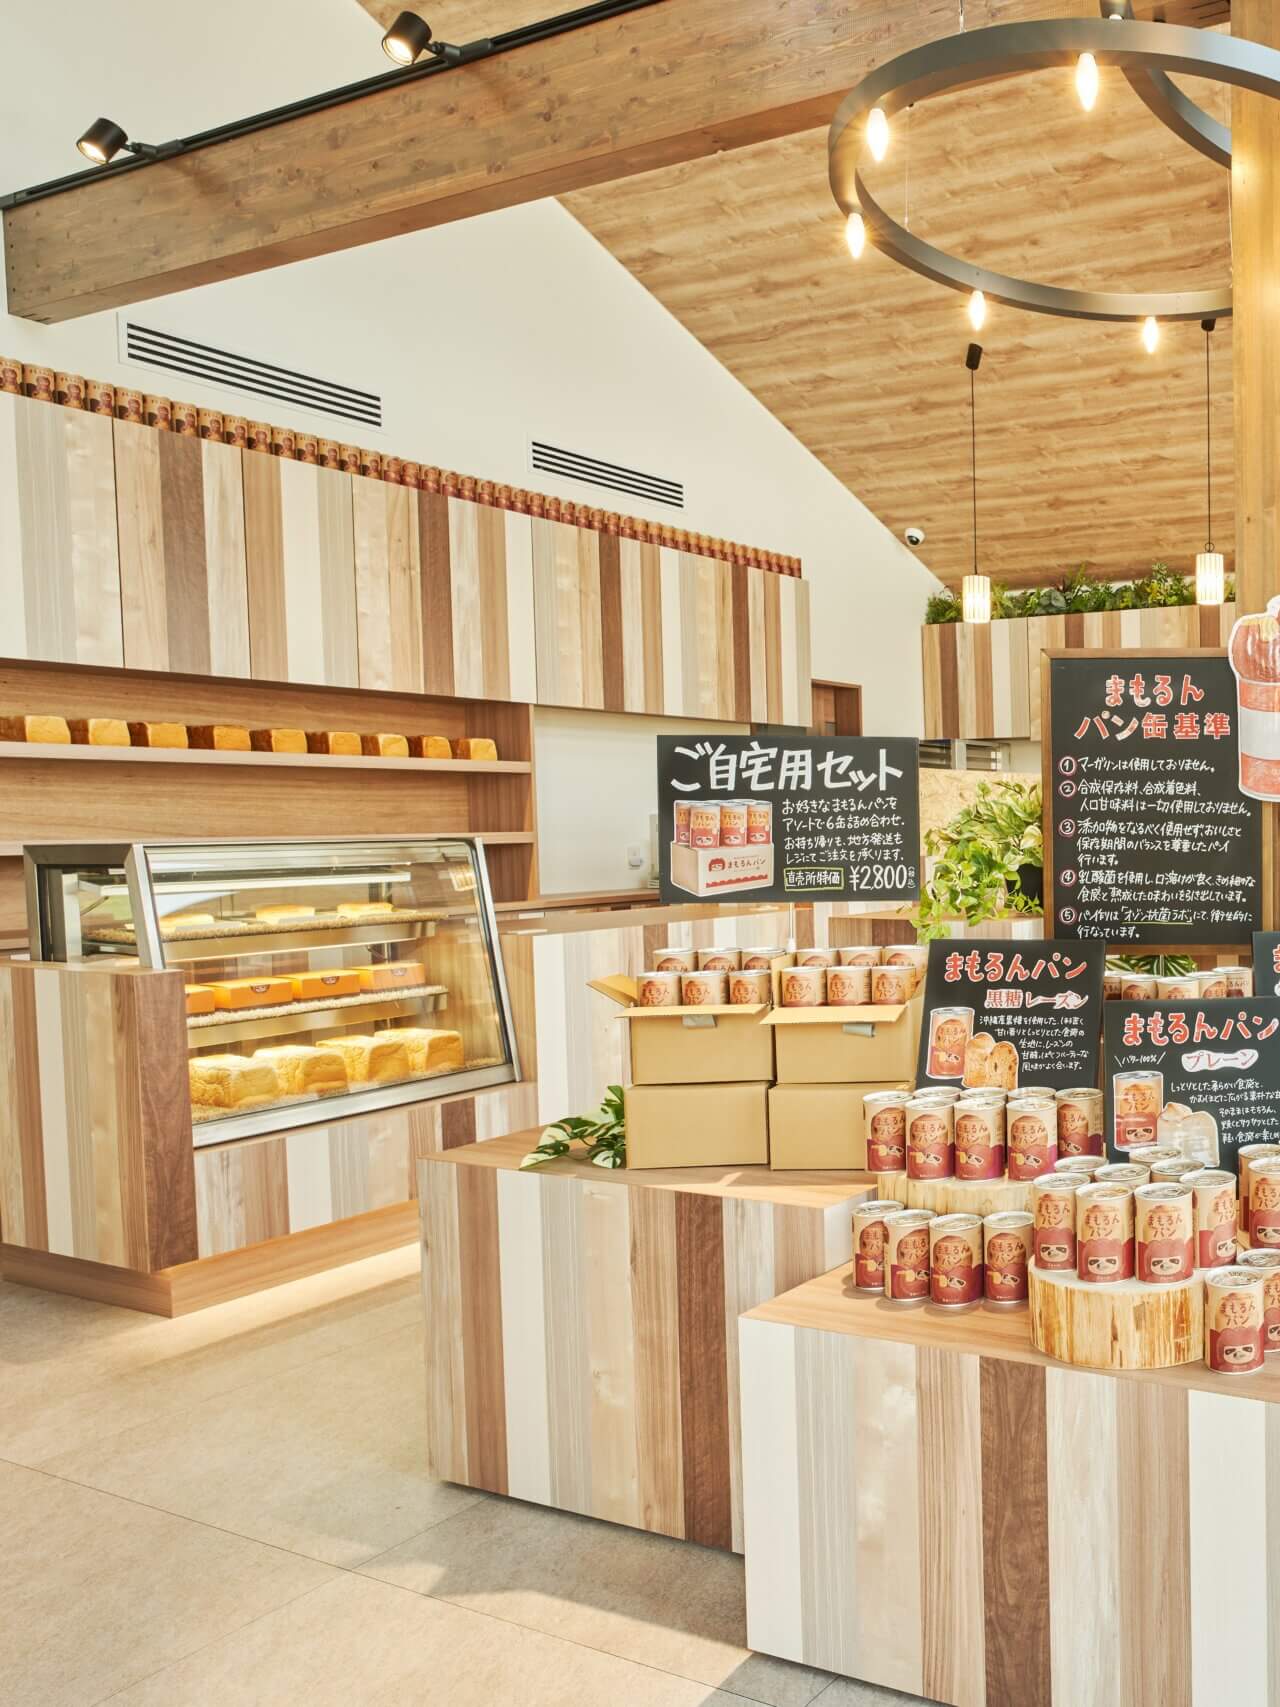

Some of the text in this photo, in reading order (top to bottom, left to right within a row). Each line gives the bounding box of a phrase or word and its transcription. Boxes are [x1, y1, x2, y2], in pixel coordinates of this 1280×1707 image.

[1104, 673, 1205, 707] まもるん
[1074, 710, 1232, 741] パン缶基準
[670, 741, 903, 792] ご自宅用セット
[782, 797, 898, 814] お好きなまもるんパンを
[786, 870, 841, 887] 直売所特価
[944, 950, 1088, 982] まもるんパン
[984, 989, 1089, 1009] 黒糖レーズン
[1122, 1011, 1279, 1046] まもるんパン
[1185, 1050, 1256, 1070] プレーン
